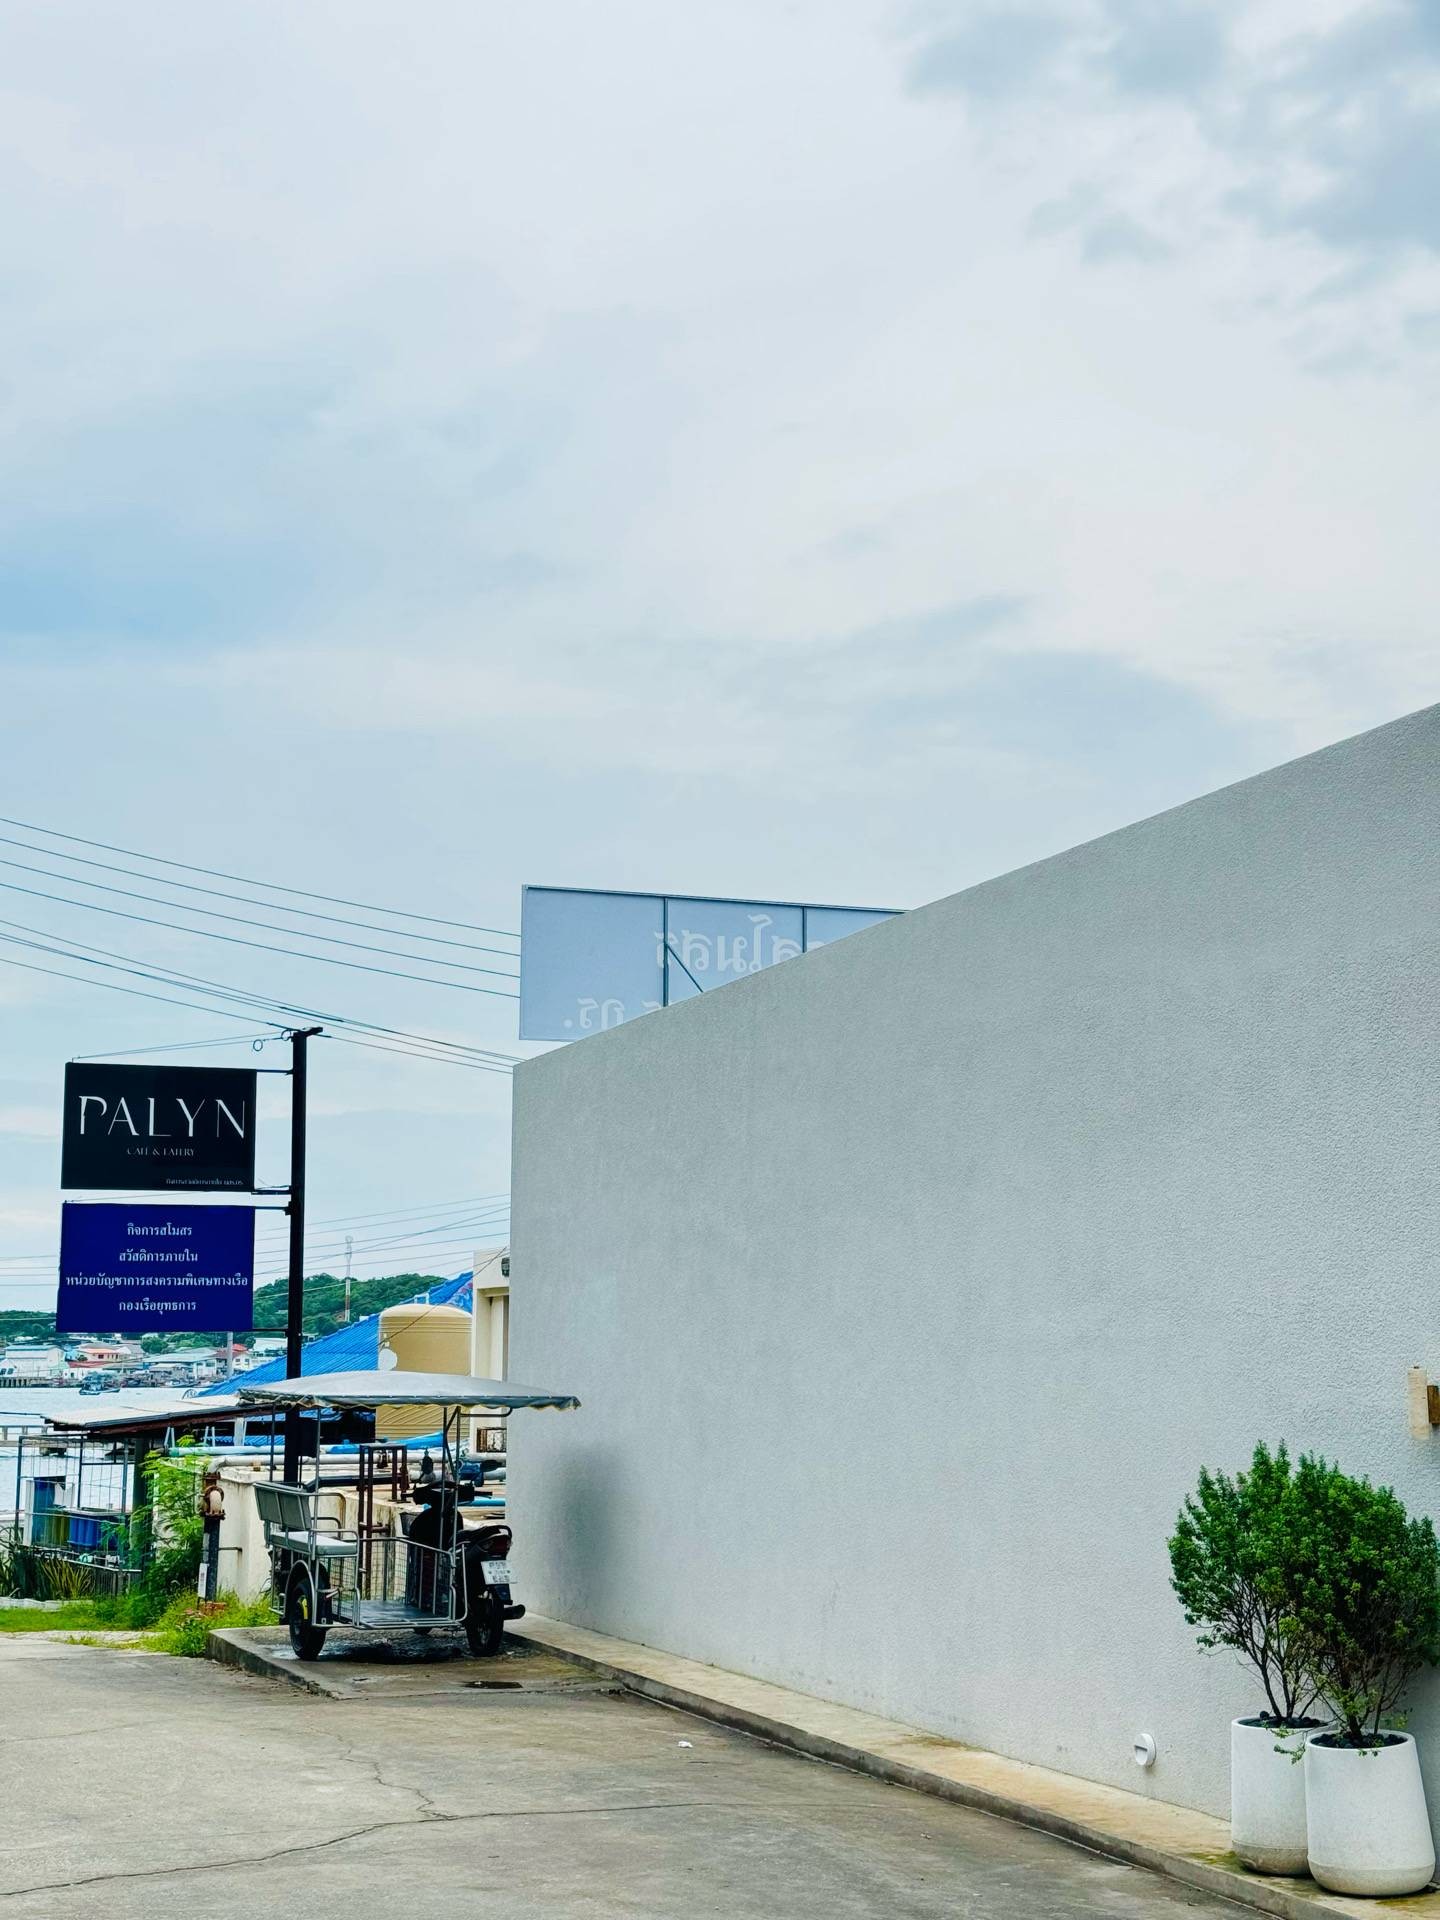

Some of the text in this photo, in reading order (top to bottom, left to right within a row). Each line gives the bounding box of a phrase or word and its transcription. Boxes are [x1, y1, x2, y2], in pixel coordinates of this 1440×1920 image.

[78, 1095, 246, 1139] PALYN
[152, 1147, 161, 1156] &
[127, 1223, 192, 1236] กิจการสโมสร
[119, 1249, 198, 1262] สวัสดิการภายใน
[66, 1273, 248, 1289] หน่วยบัญชาการสงครามพิเศษทางเรือ
[119, 1298, 197, 1315] กองเรือยุทธการ
